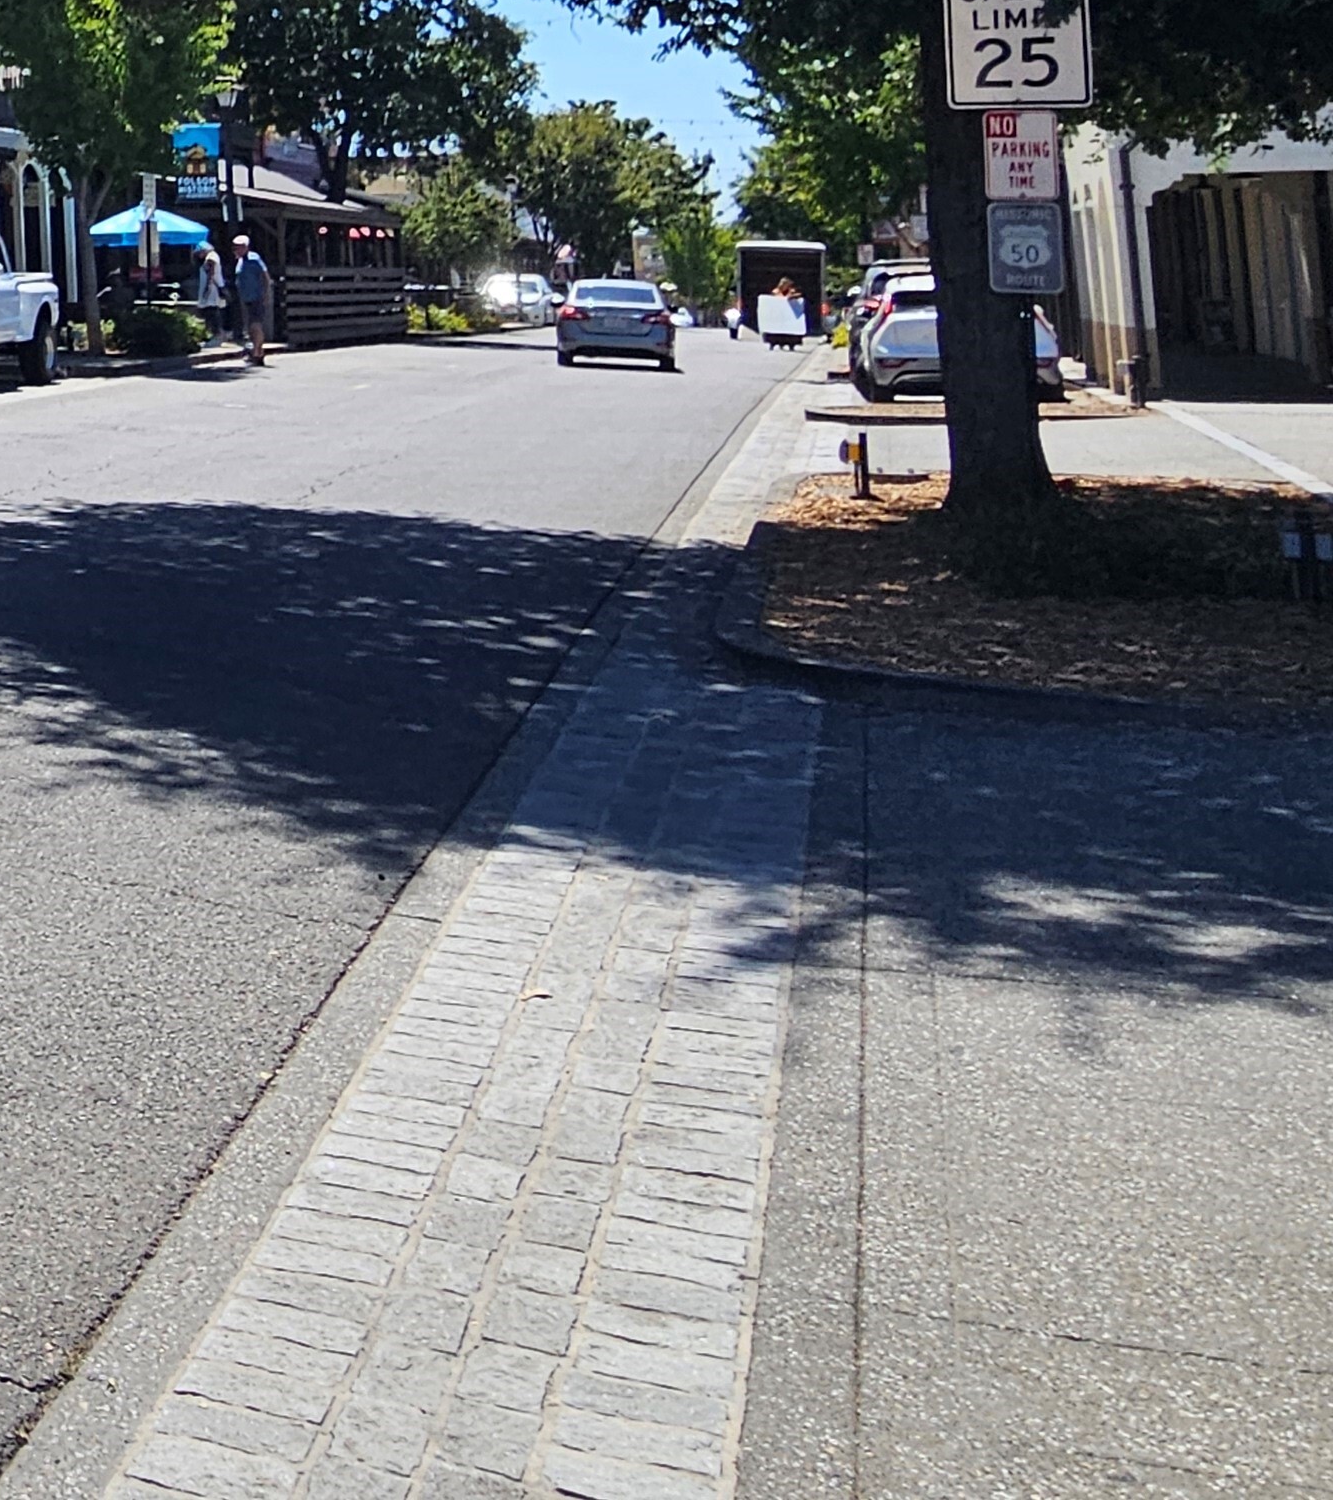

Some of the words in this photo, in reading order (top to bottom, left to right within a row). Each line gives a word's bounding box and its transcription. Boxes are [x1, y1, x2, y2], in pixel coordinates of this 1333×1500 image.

[974, 37, 1059, 89] 25
[989, 115, 1014, 136] NO
[992, 140, 1050, 159] PARKING
[1009, 161, 1035, 174] ANY
[1009, 175, 1036, 190] TIME
[1010, 243, 1040, 264] 50
[1005, 272, 1046, 288] ROUTE
